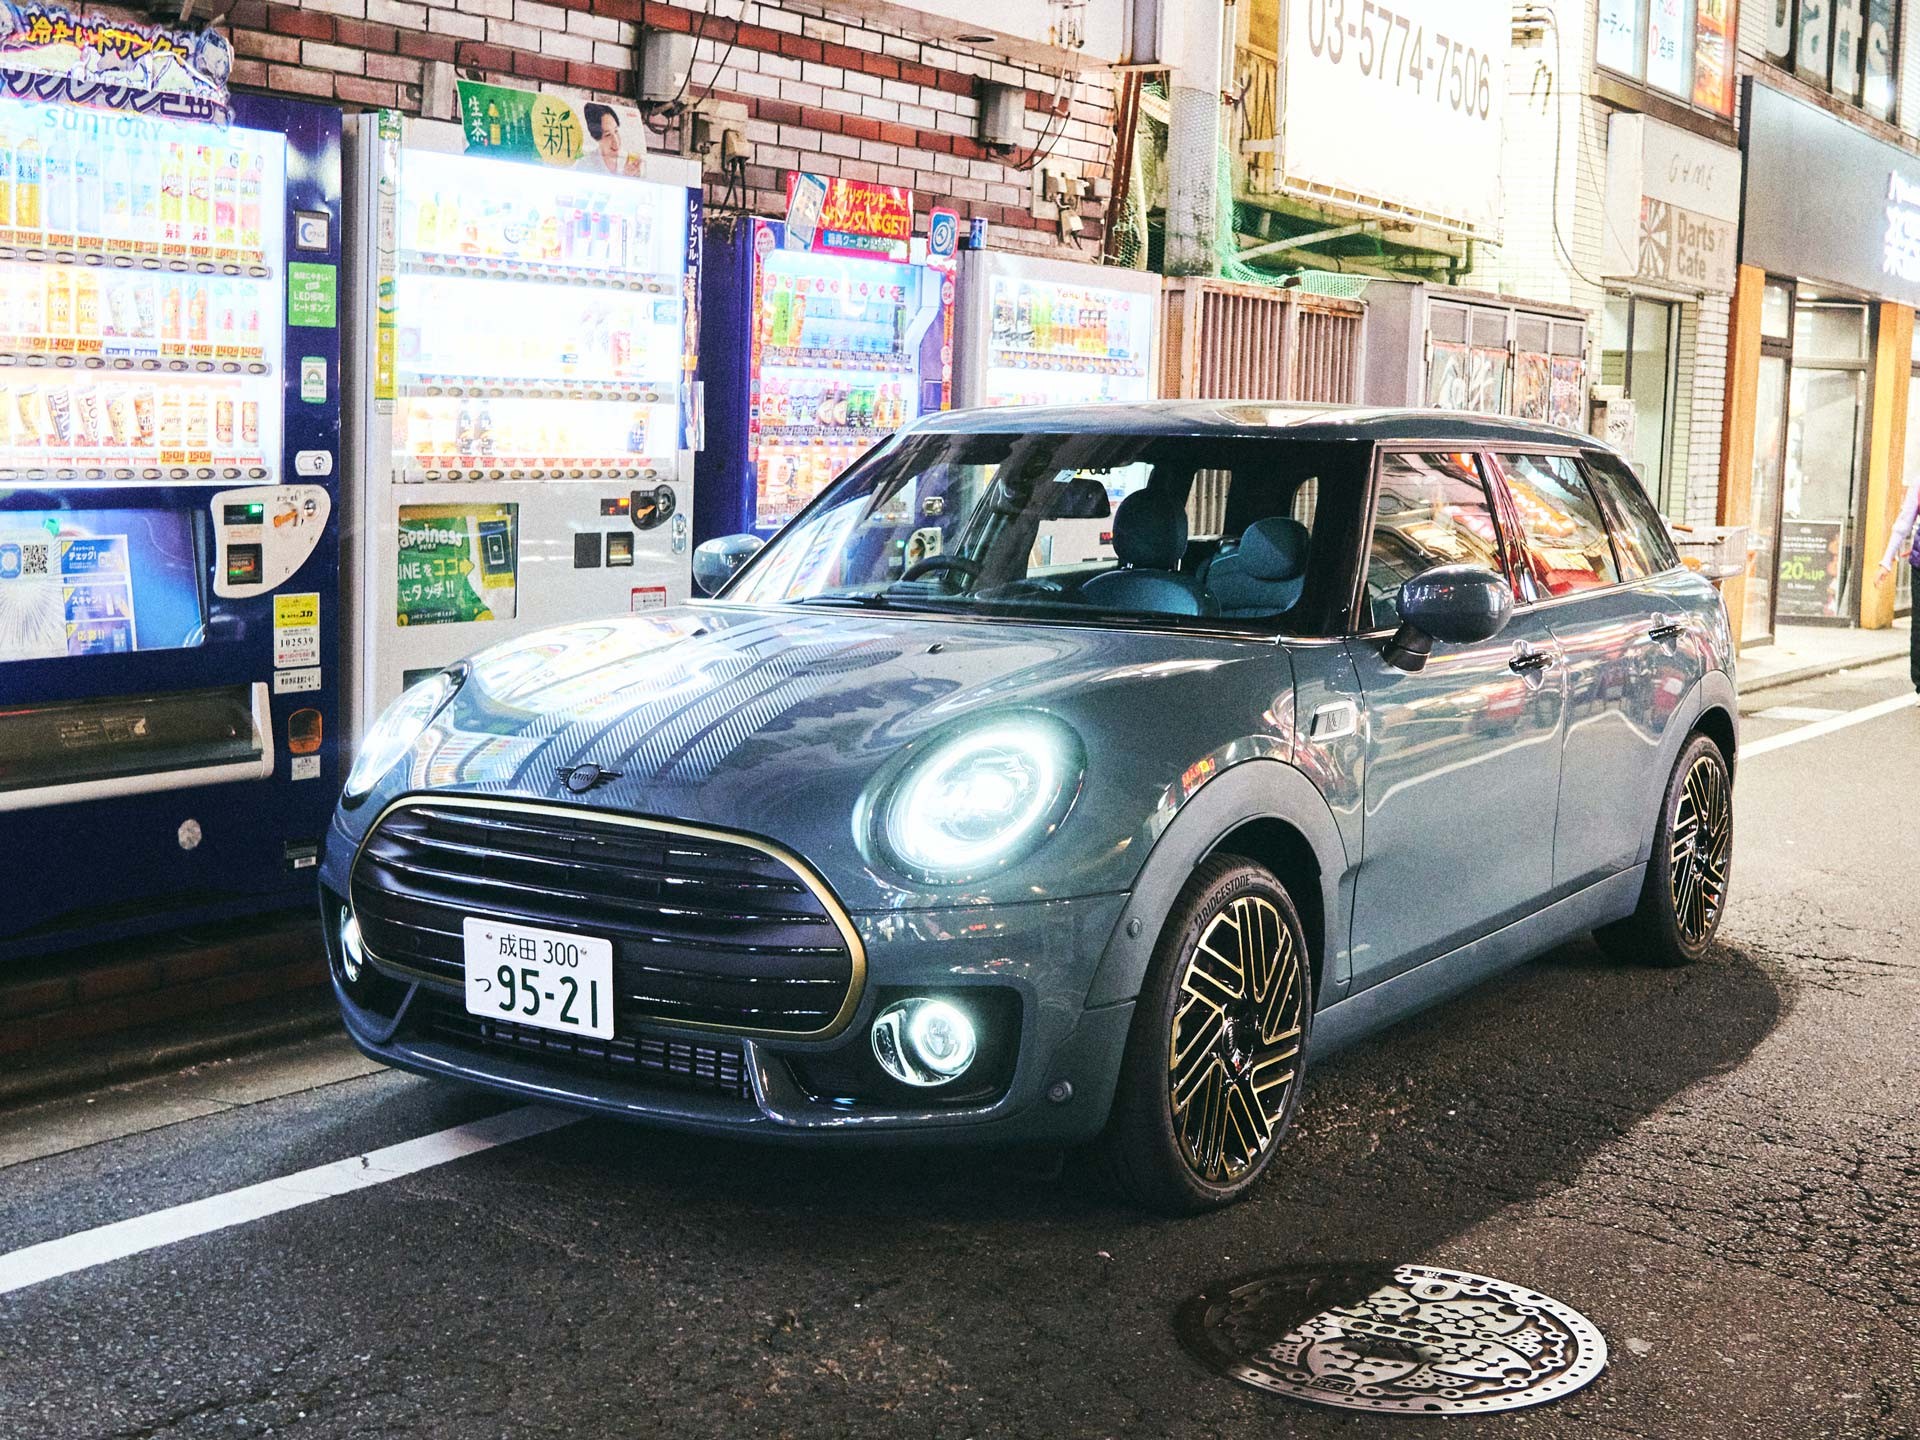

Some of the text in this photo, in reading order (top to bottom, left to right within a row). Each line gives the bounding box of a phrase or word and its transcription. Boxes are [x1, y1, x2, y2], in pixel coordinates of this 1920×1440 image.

[1308, 0, 1490, 121] 03-5774-7506
[468, 95, 488, 143] 生茶
[541, 106, 576, 158] 新
[1677, 212, 1715, 251] Darts
[1677, 248, 1707, 281] Cafe
[280, 636, 314, 648] 102539
[571, 771, 594, 781] MINI
[1194, 873, 1251, 927] BRIDGESTONE
[499, 933, 579, 968] 成田 300
[474, 964, 599, 1029] つ 95-21
